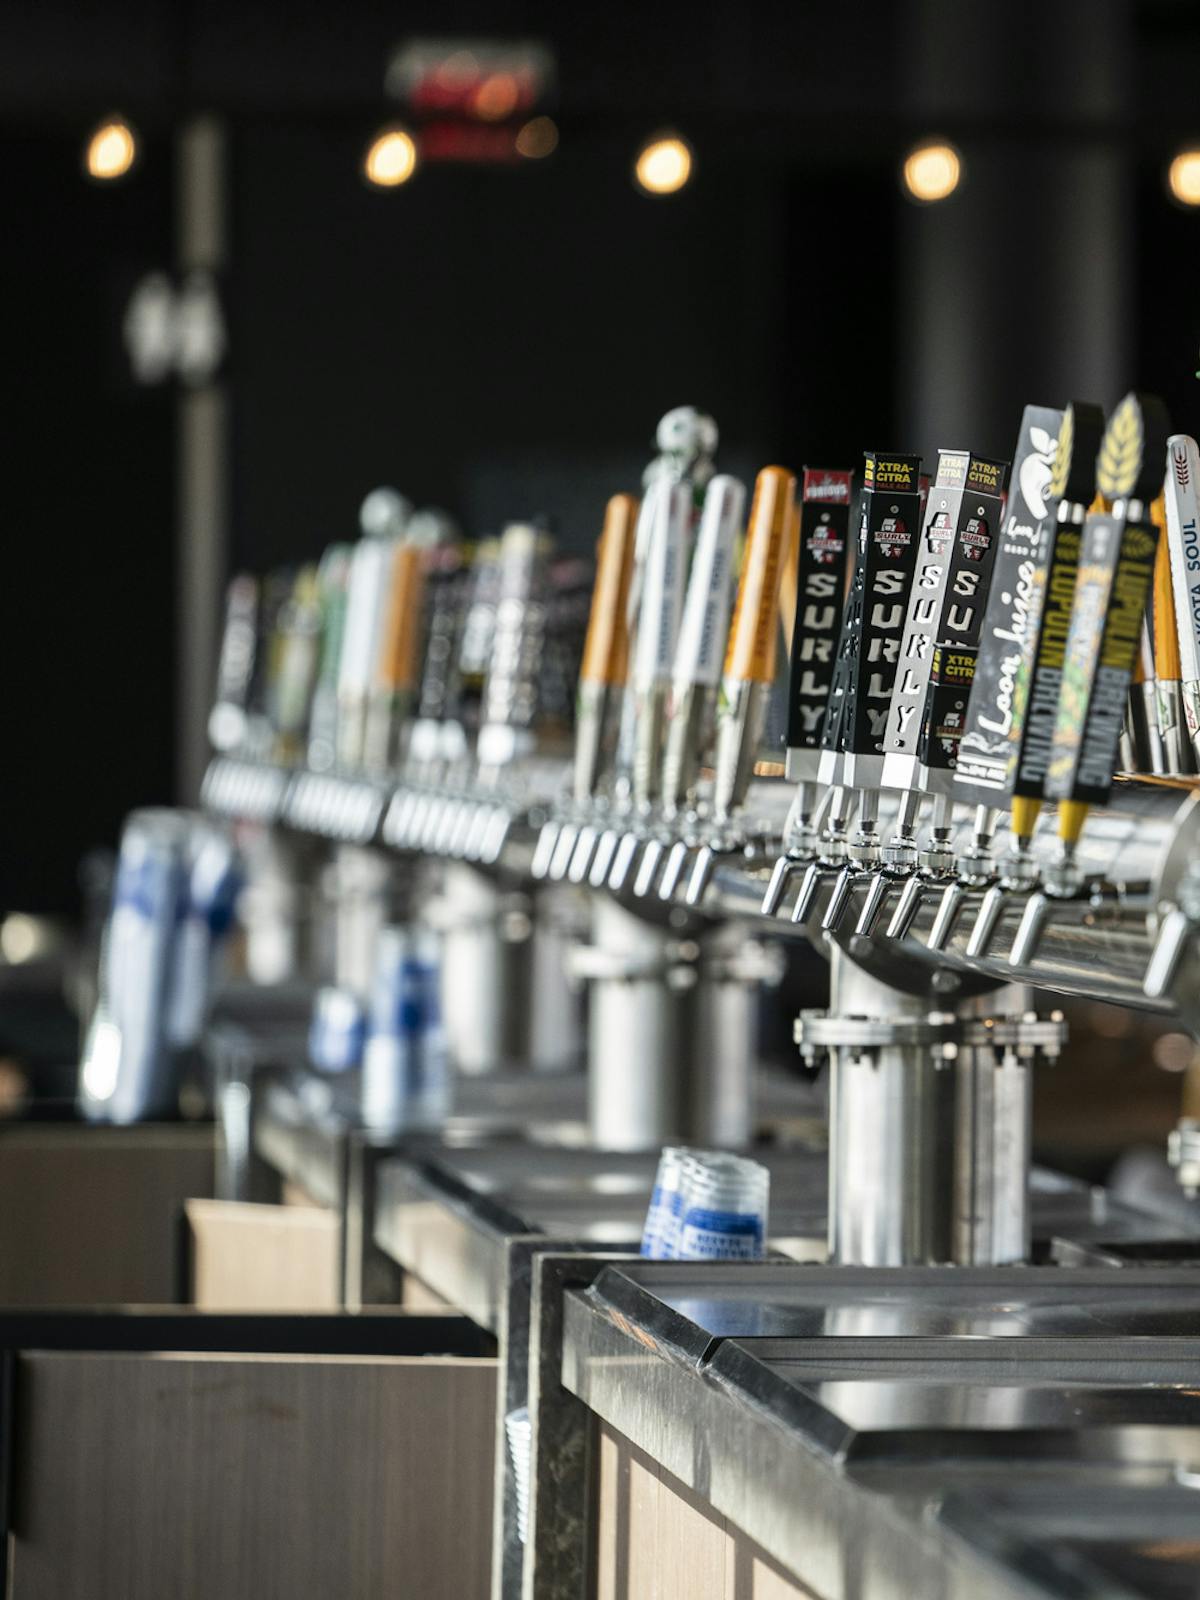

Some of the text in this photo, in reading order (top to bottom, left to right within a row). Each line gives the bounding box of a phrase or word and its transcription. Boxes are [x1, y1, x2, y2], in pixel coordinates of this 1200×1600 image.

[876, 472, 911, 483] CITRA
[877, 461, 914, 473] XTRA-
[968, 472, 997, 487] CITRA
[971, 461, 1000, 476] XTRA-
[875, 532, 911, 541] SURLY
[960, 532, 990, 545] SURLY
[1183, 518, 1200, 572] SOUL
[993, 560, 1036, 648] Juice
[1101, 558, 1151, 670] LUPULIN
[799, 572, 838, 732] SURLY
[866, 569, 906, 736] SURLY
[894, 563, 942, 734] SURLY
[1020, 563, 1078, 782] LUPULIN BREWING
[977, 654, 1021, 736] Loon
